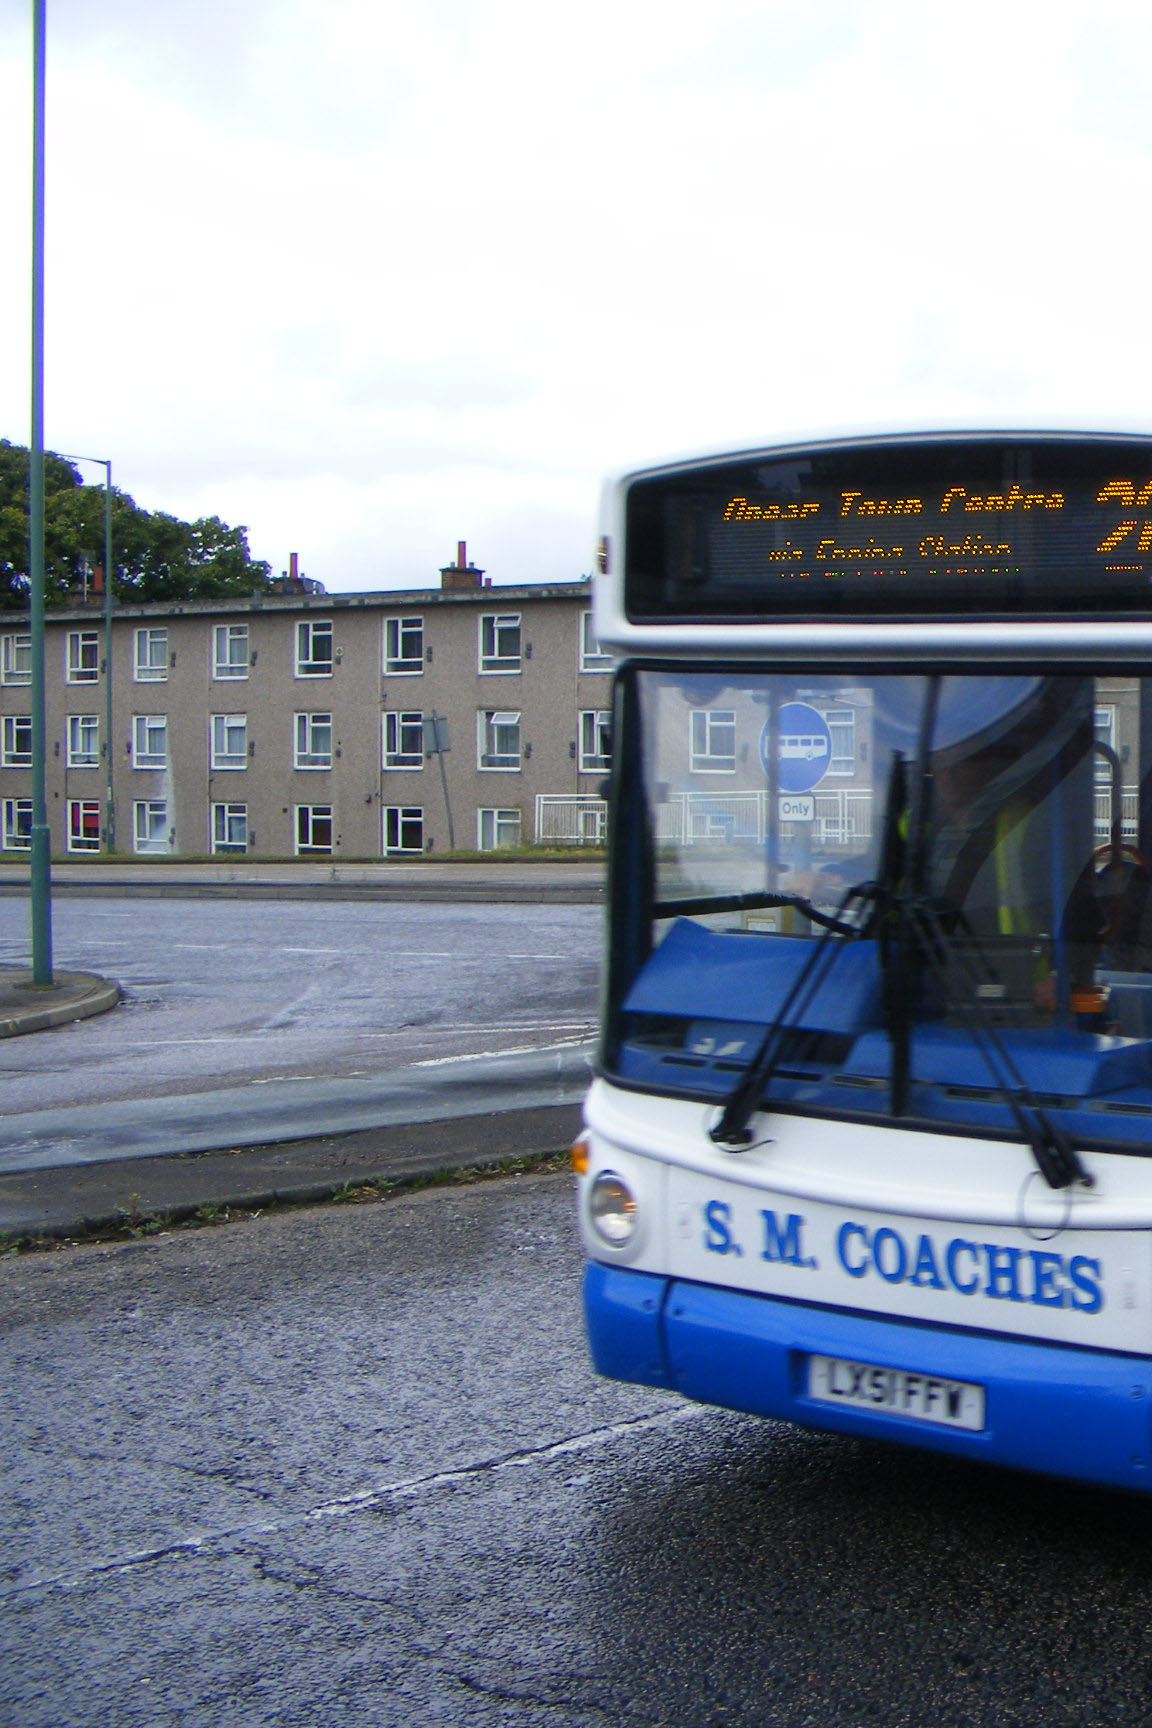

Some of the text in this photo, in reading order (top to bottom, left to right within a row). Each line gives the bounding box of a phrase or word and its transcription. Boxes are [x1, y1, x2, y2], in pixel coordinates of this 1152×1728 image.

[782, 802, 810, 816] Only
[704, 1199, 1105, 1315] S. M. COACHES
